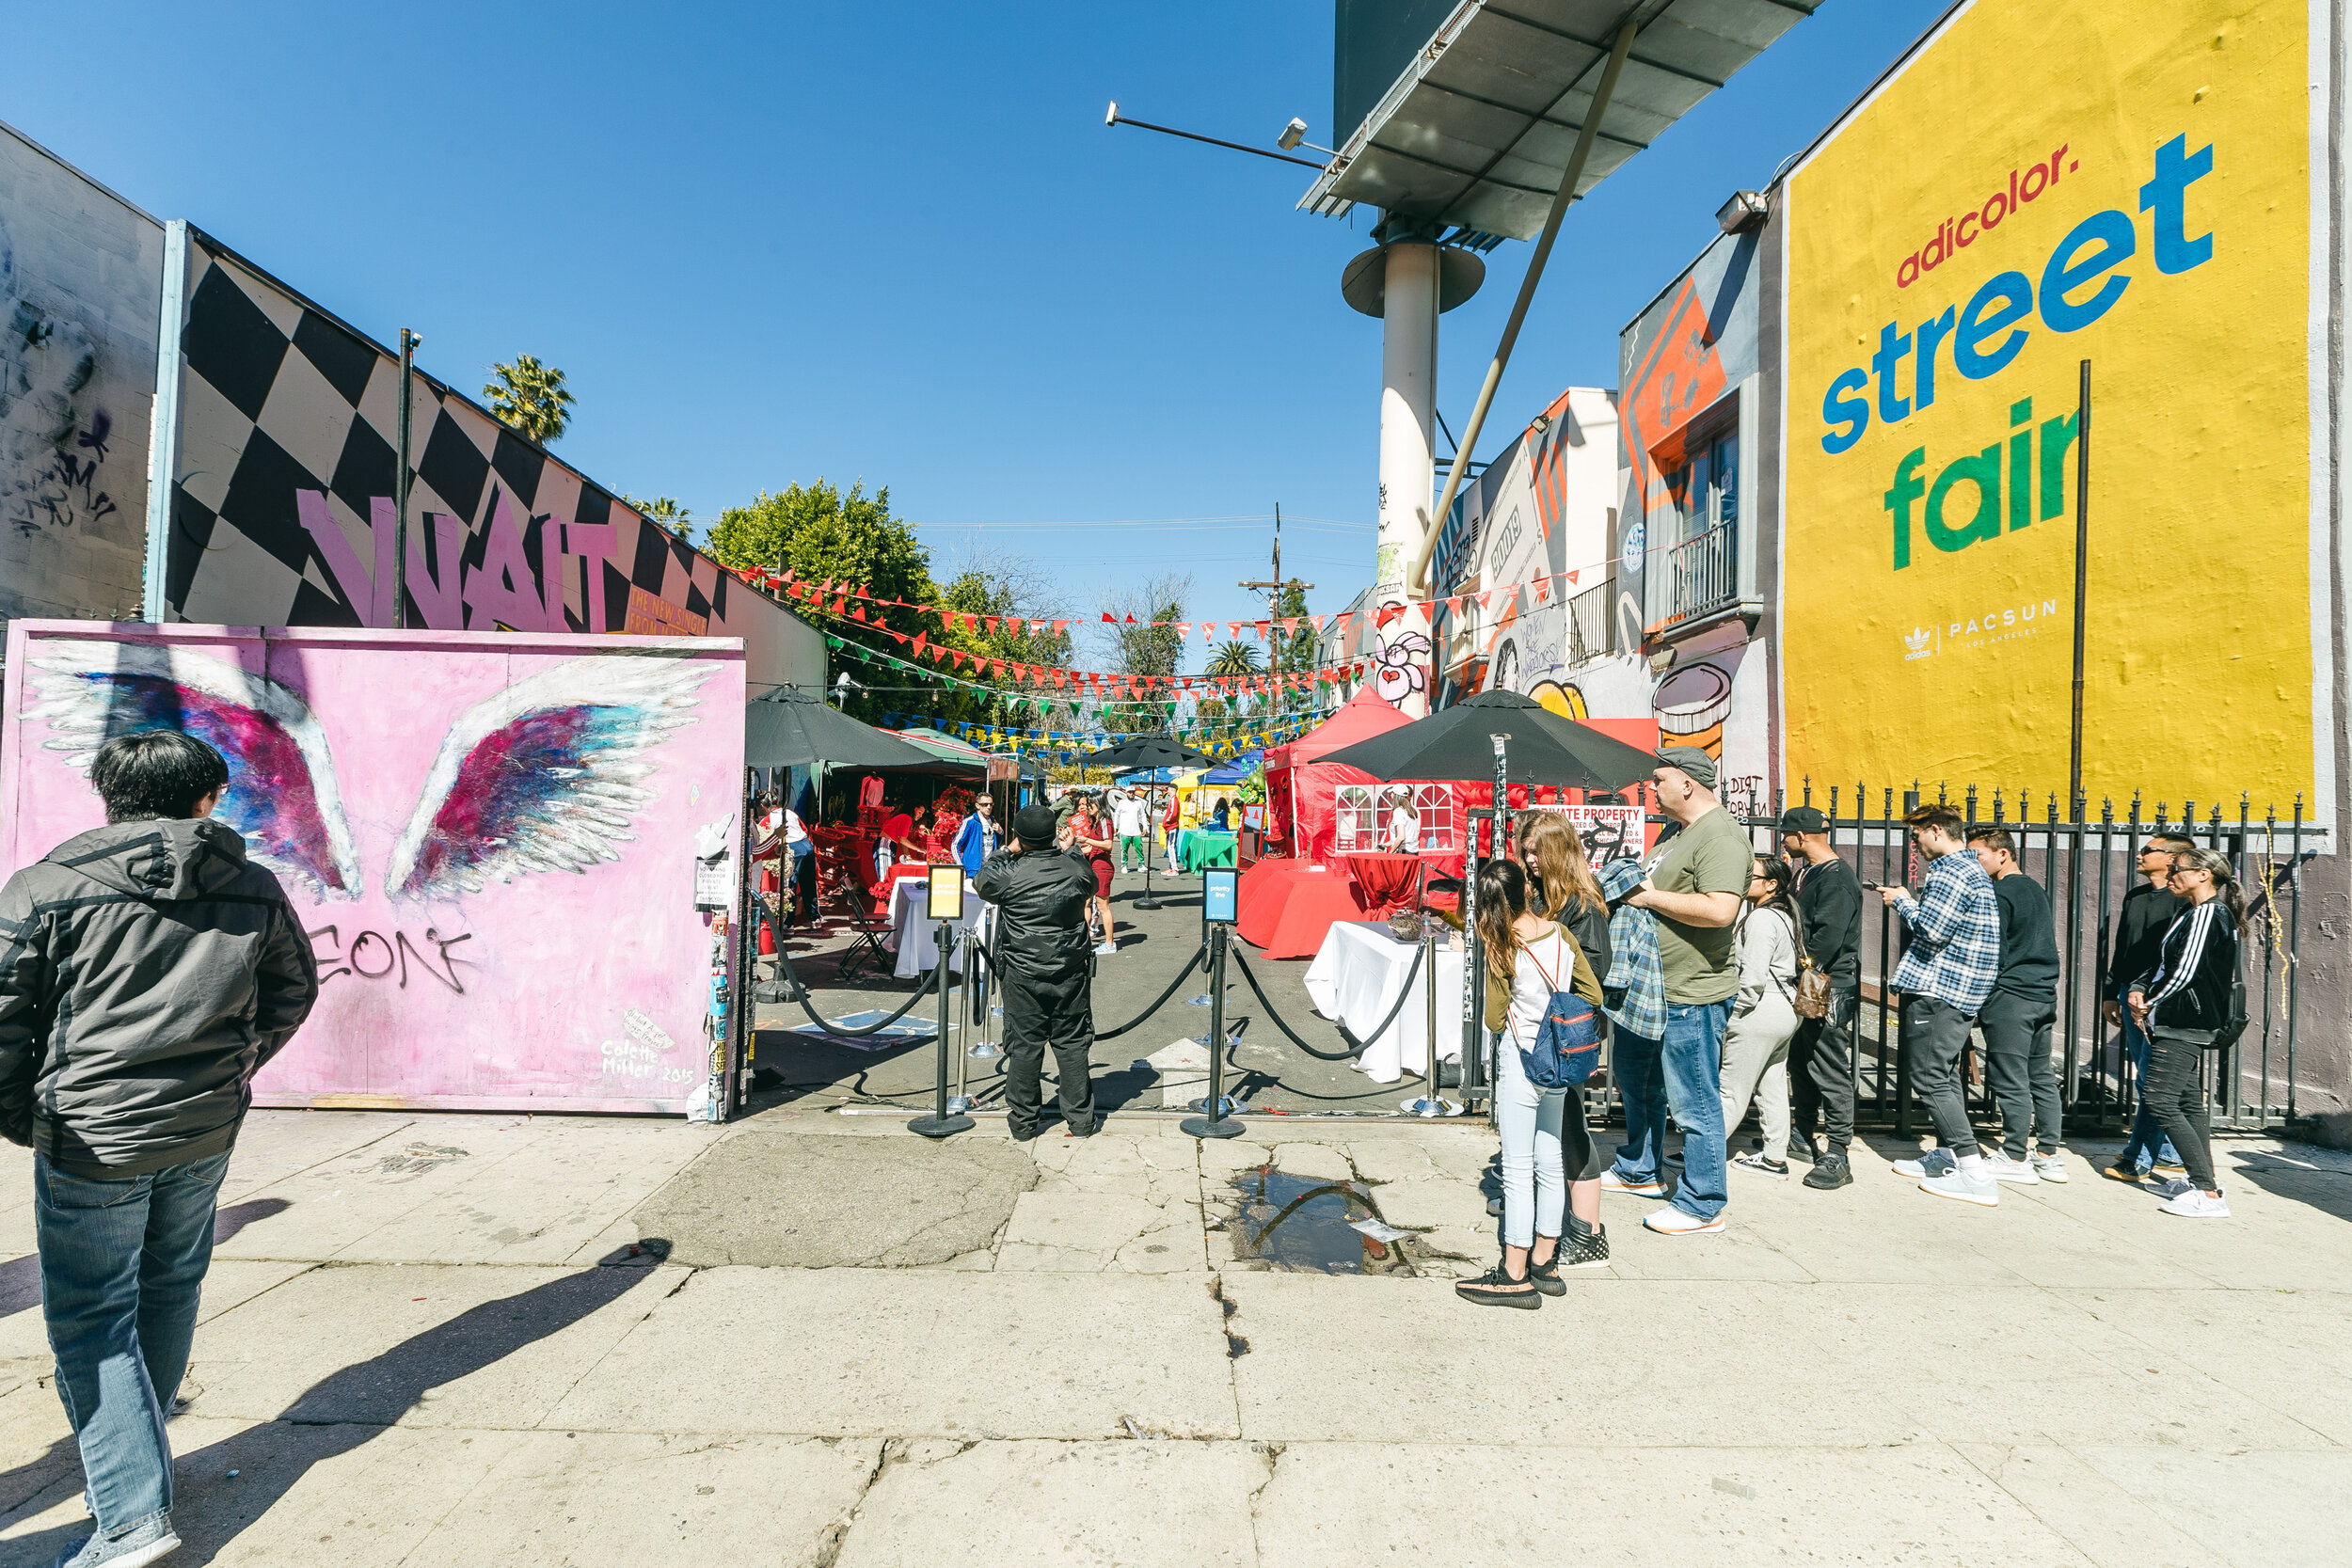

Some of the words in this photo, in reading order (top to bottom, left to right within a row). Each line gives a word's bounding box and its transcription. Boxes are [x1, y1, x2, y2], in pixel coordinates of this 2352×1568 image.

[1898, 142, 2079, 289] adicolor.
[1820, 132, 2214, 455] street
[1884, 396, 2092, 571] fair
[296, 486, 618, 633] WAIT
[1492, 511, 1521, 578] 90019
[629, 612, 656, 635] FROM
[632, 588, 648, 611] THE
[652, 598, 675, 622] NEW
[676, 609, 707, 636] SINGLE
[1904, 650, 1931, 661] adidas
[1949, 599, 2057, 639] PACSUN
[1966, 641, 1985, 649] LOS
[1991, 627, 2037, 643] ANGELES
[1534, 808, 1580, 819] VATE
[1583, 808, 1640, 821] PROPERTY
[1727, 800, 1767, 816] OBAN
[600, 1038, 660, 1064] Colette
[602, 1057, 657, 1078] Miller
[661, 1066, 694, 1085] 2015
